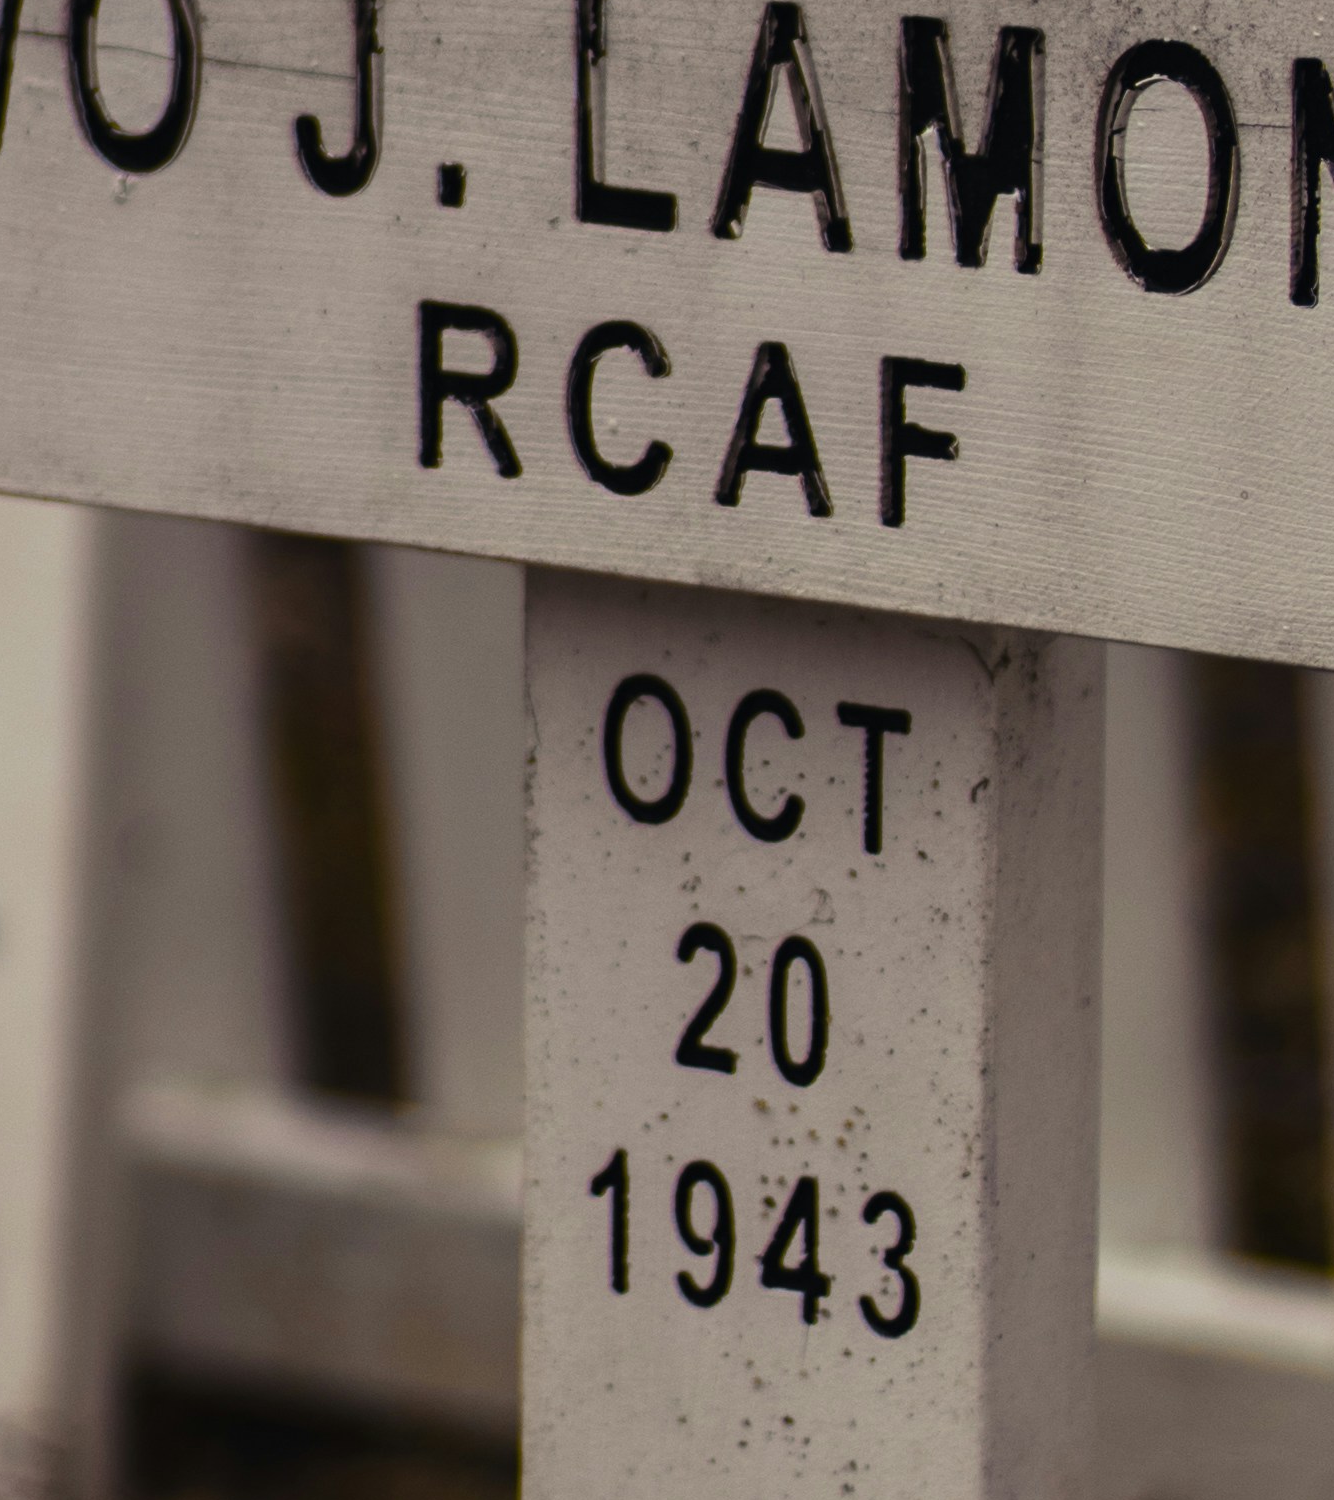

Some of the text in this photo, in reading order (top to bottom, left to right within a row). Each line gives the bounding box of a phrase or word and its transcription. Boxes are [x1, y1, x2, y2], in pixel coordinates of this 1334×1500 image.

[417, 299, 967, 528] RCAF
[603, 673, 912, 856] OCT
[675, 922, 830, 1087] 20
[591, 1148, 920, 1338] 1943
